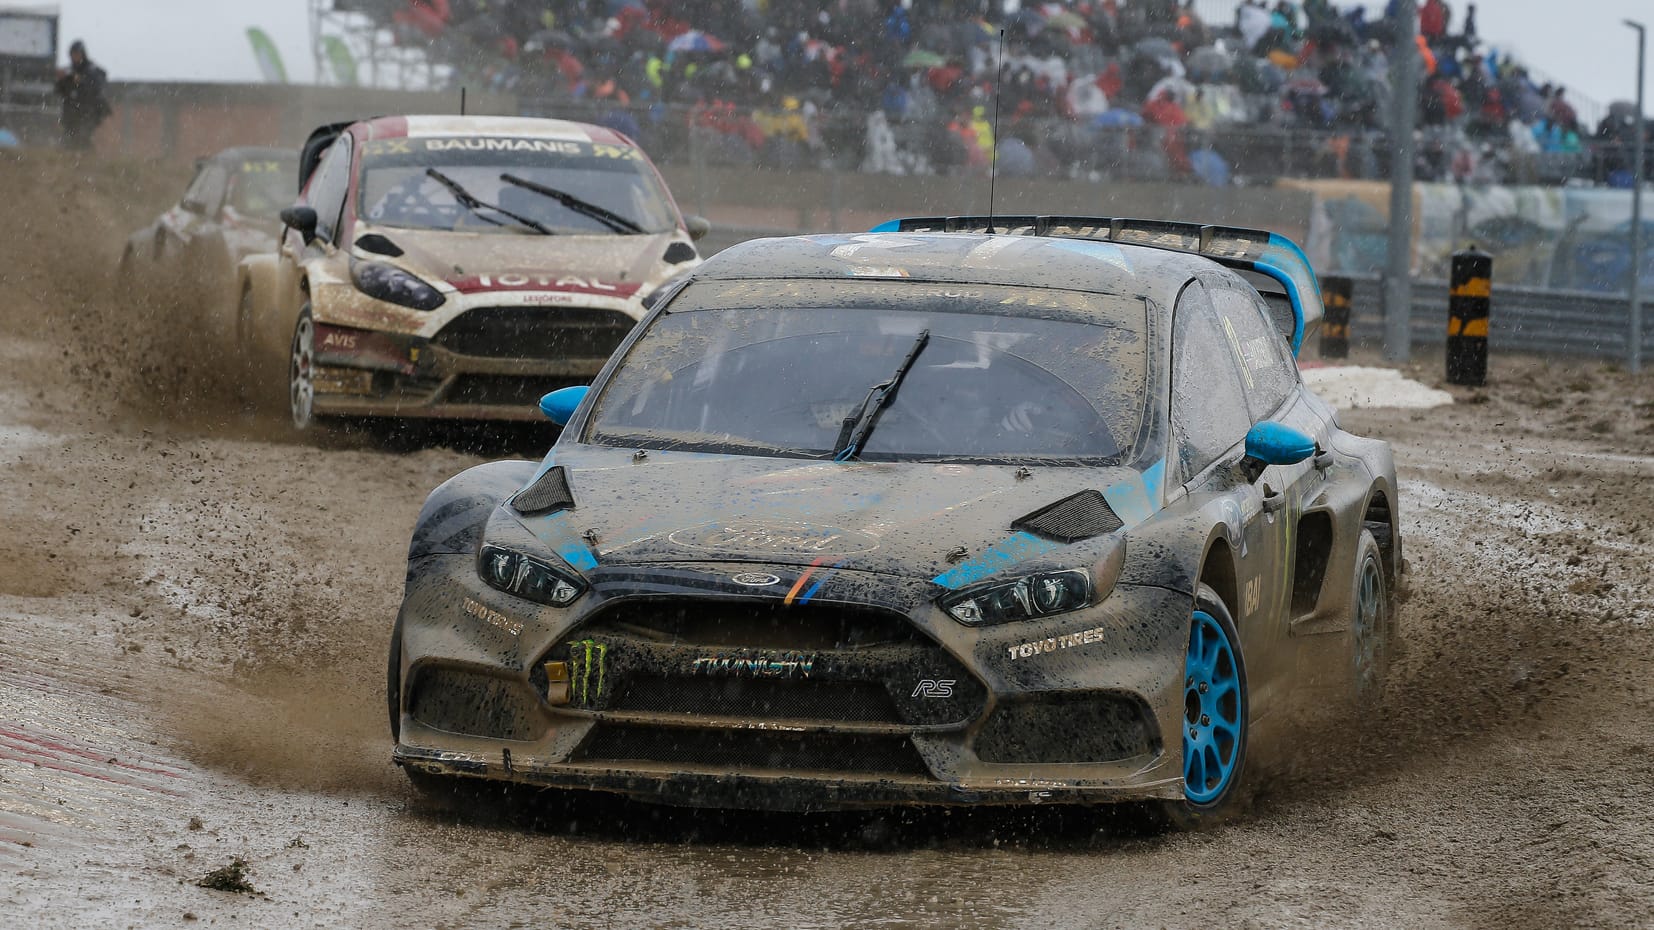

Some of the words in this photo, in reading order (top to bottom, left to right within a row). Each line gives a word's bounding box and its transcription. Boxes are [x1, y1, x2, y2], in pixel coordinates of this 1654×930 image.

[425, 138, 581, 154] BAUMANIS
[479, 272, 617, 291] TOTAL
[323, 333, 356, 349] AVIS
[1008, 638, 1057, 660] TOYO
[1057, 626, 1104, 649] TIRES
[911, 679, 957, 698] RS
